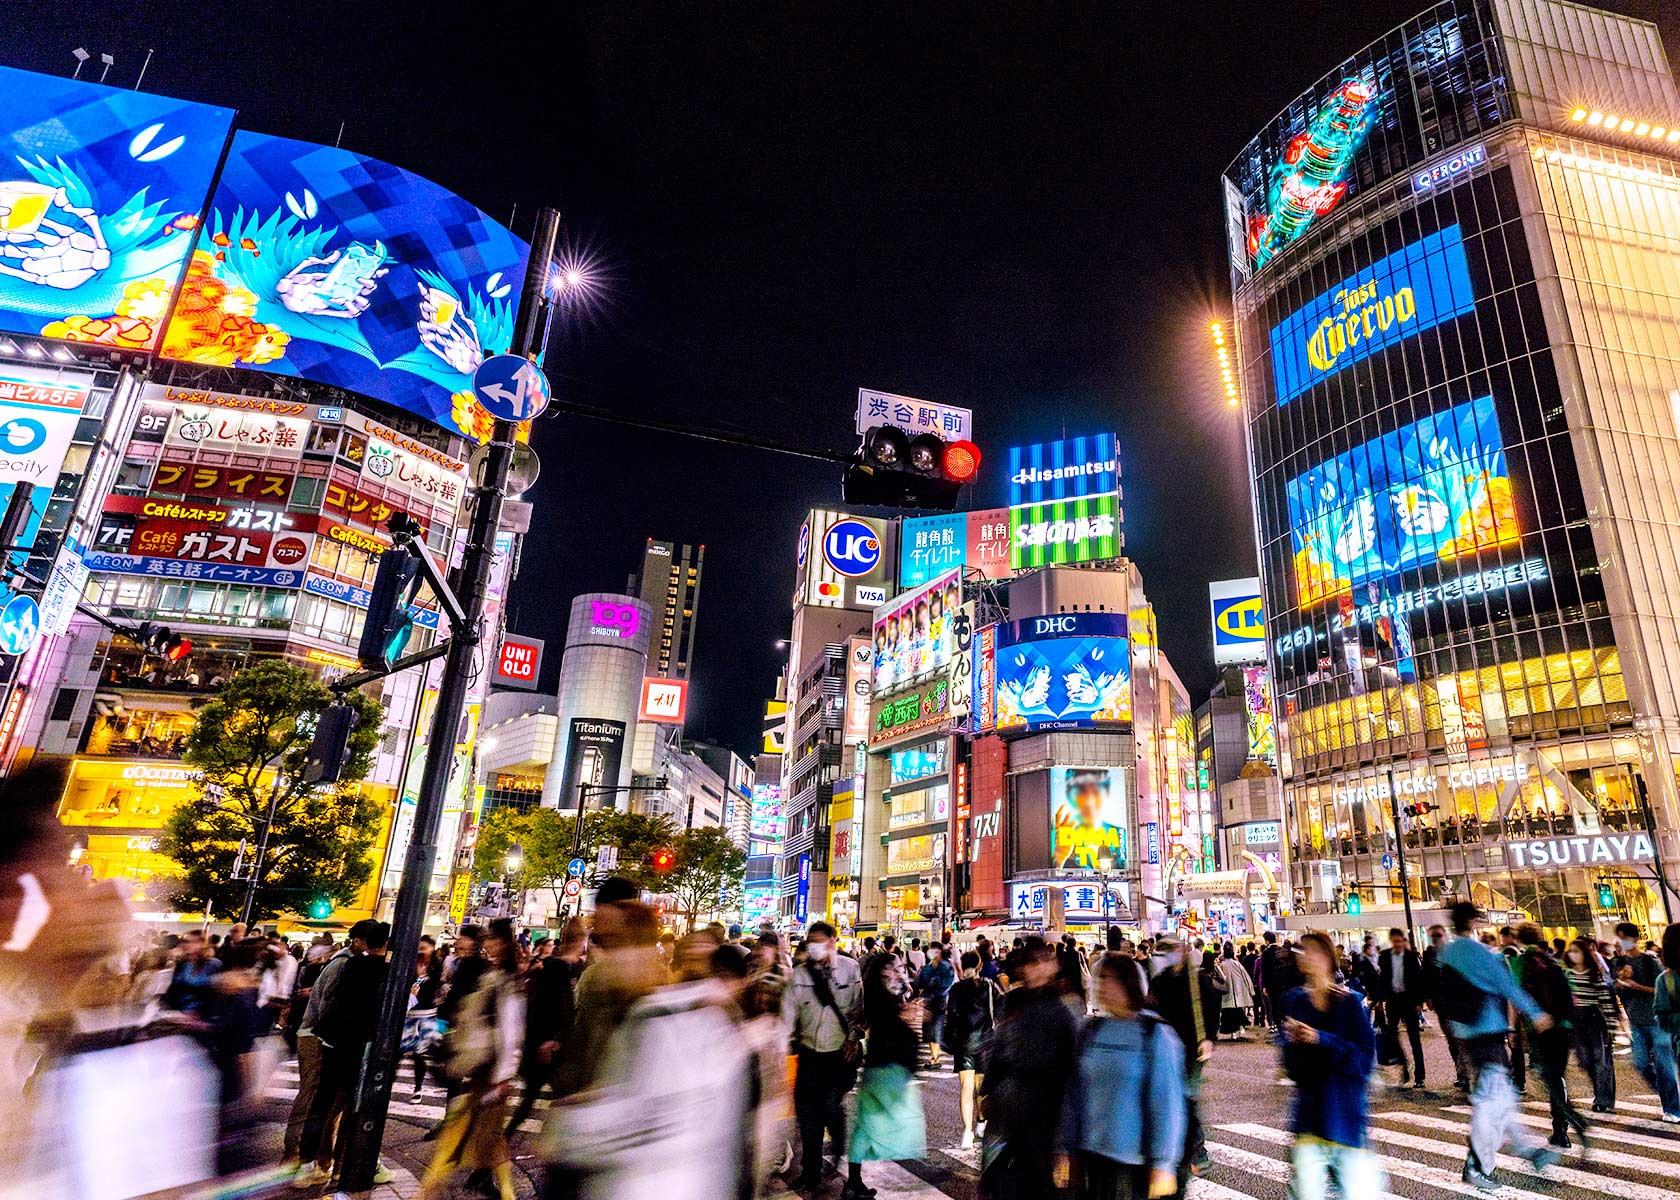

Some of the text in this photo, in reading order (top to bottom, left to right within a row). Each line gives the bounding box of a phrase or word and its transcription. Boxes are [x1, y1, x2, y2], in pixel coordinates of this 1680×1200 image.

[166, 386, 307, 415] しゃぶしゃぶバイキング
[140, 414, 167, 431] 9F
[868, 397, 962, 433] 渋谷駅前
[218, 420, 298, 448] しゃぶ葉
[365, 419, 464, 472] しゃぶしゃぶバイキング
[157, 465, 285, 497] プライス
[398, 462, 457, 501] しゃぶ葉
[228, 508, 293, 531] ガスト
[100, 526, 134, 545] 7F
[140, 530, 177, 545] Café
[915, 528, 954, 548] 龍角散
[981, 523, 1010, 541] 龍角
[177, 532, 262, 562] ガスト
[276, 549, 303, 558] ガスト
[93, 555, 133, 569] AEON
[147, 561, 268, 581] 英会話イーオン
[312, 578, 344, 596] AEON
[860, 590, 884, 602] VISA
[592, 601, 639, 638] 109
[1035, 616, 1077, 634] DHC
[591, 627, 619, 637] SHIBUYA
[506, 646, 531, 660] UNI
[954, 607, 972, 711] もんじゃ
[503, 660, 531, 676] QLO
[653, 694, 676, 707] HM
[574, 721, 621, 736] Titanium
[1447, 763, 1529, 788] COFFEE
[1509, 834, 1655, 867] TSUTAYA
